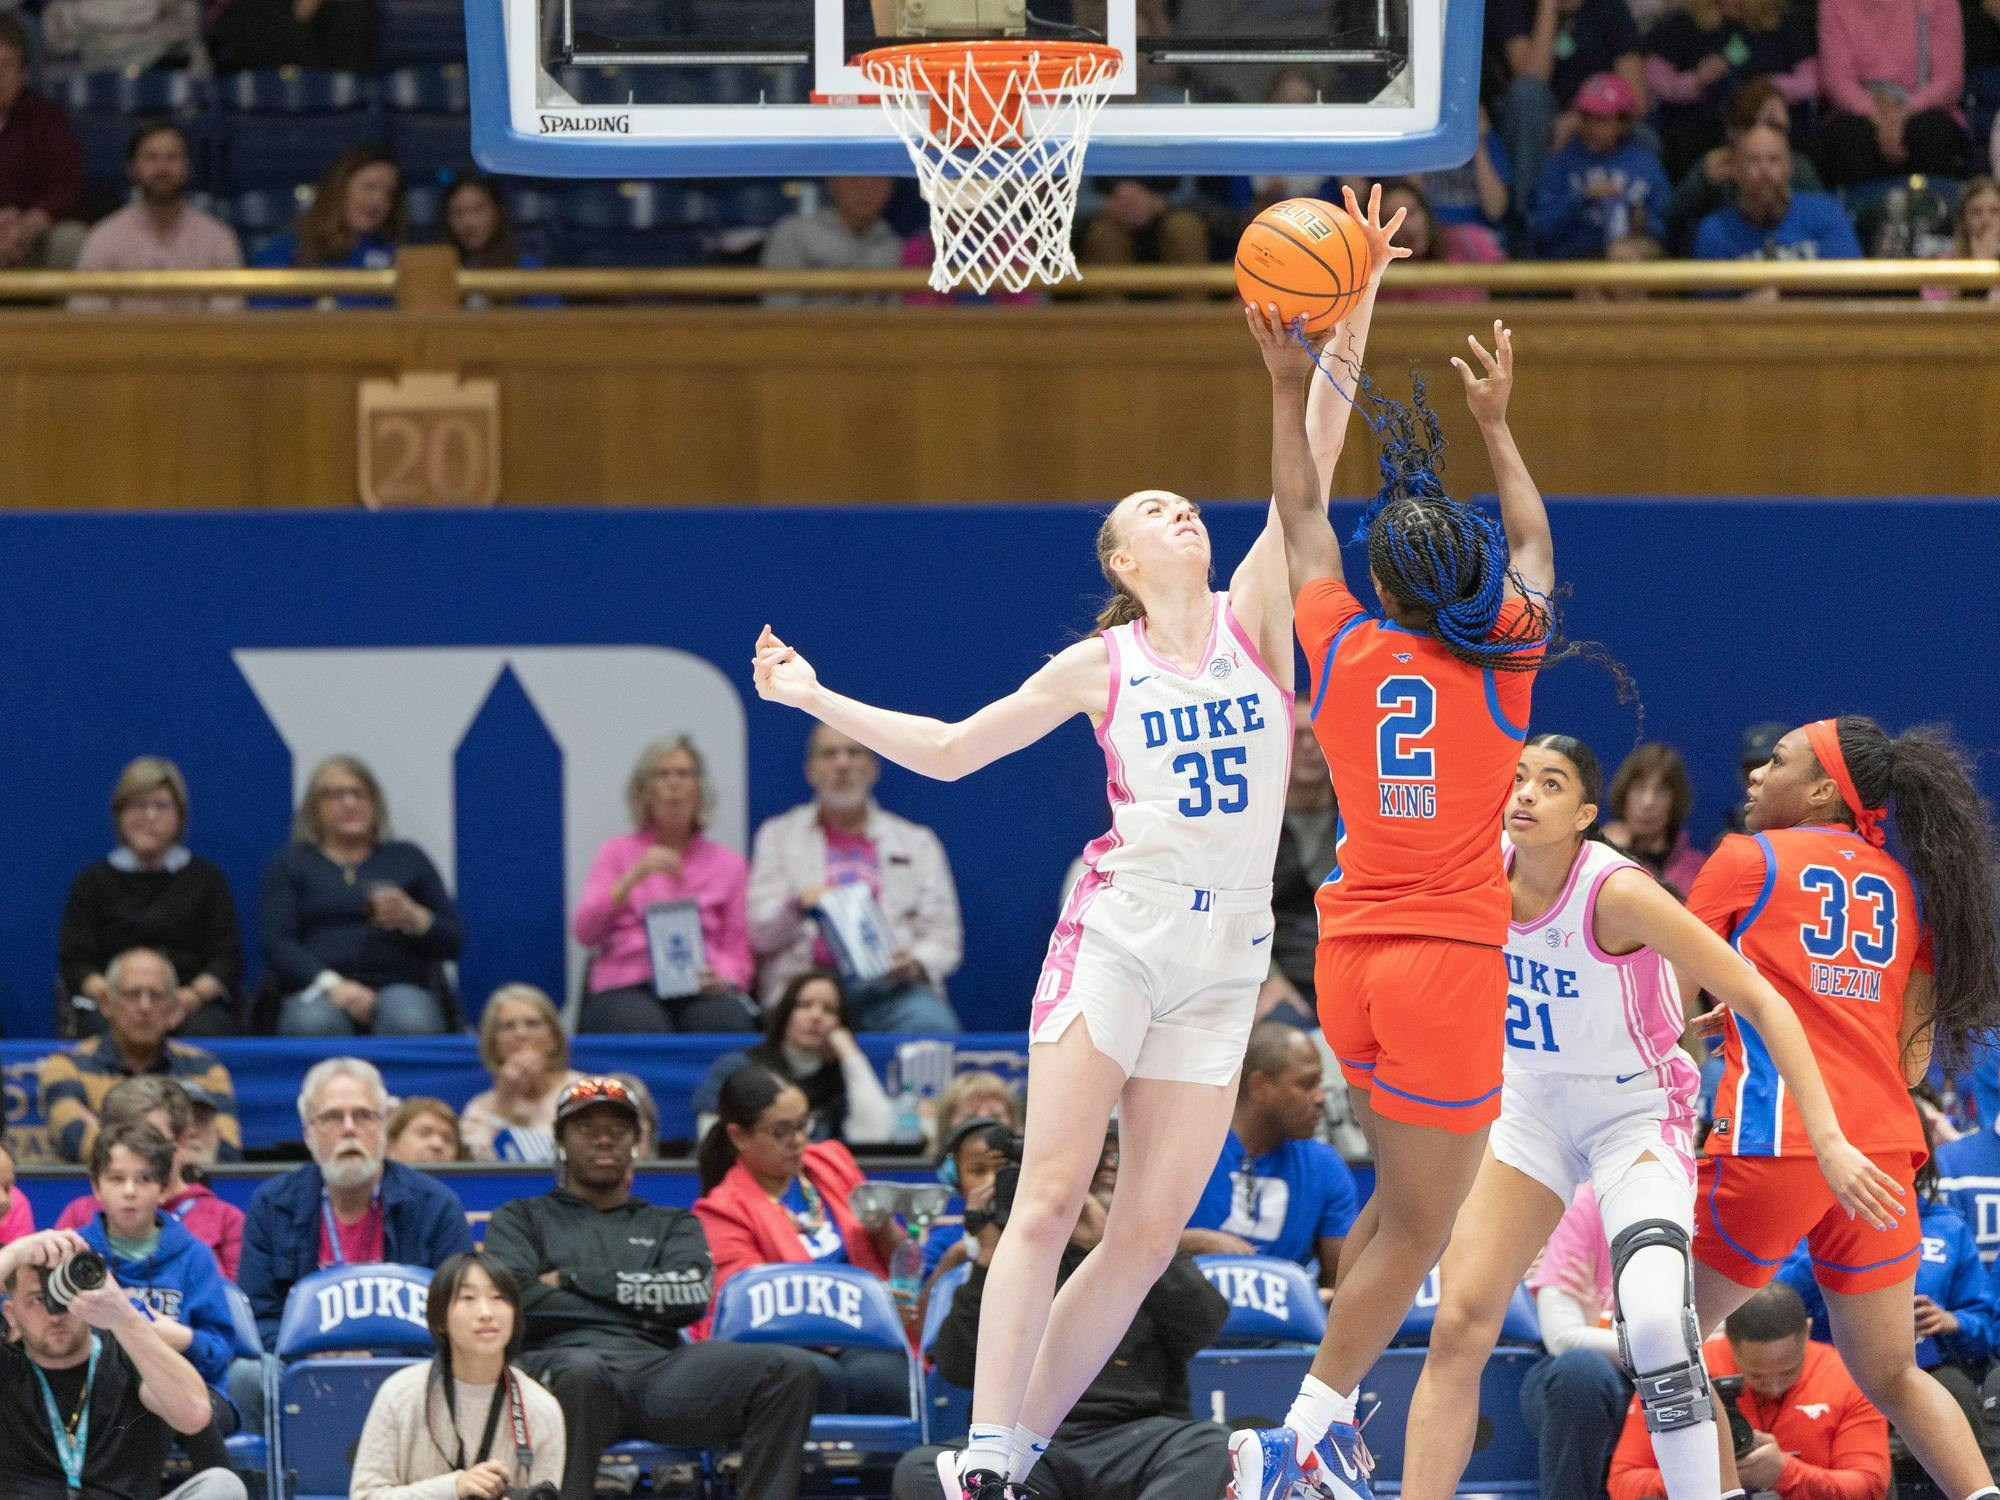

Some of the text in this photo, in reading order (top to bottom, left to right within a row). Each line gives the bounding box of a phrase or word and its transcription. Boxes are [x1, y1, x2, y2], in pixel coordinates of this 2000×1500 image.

[539, 114, 630, 134] SPALDING
[372, 418, 481, 502] 20
[1140, 693, 1265, 749] DUKE
[1376, 675, 1437, 779] 2
[1172, 746, 1249, 817] 35
[1378, 782, 1437, 819] KING
[1799, 864, 1898, 968] 33
[1504, 952, 1579, 998] UKE
[1810, 962, 1881, 1003] IBEZIM
[1505, 993, 1560, 1052] 21
[316, 1277, 430, 1333] DUKE
[616, 1282, 712, 1314] umbia
[747, 1275, 862, 1330] DUKE
